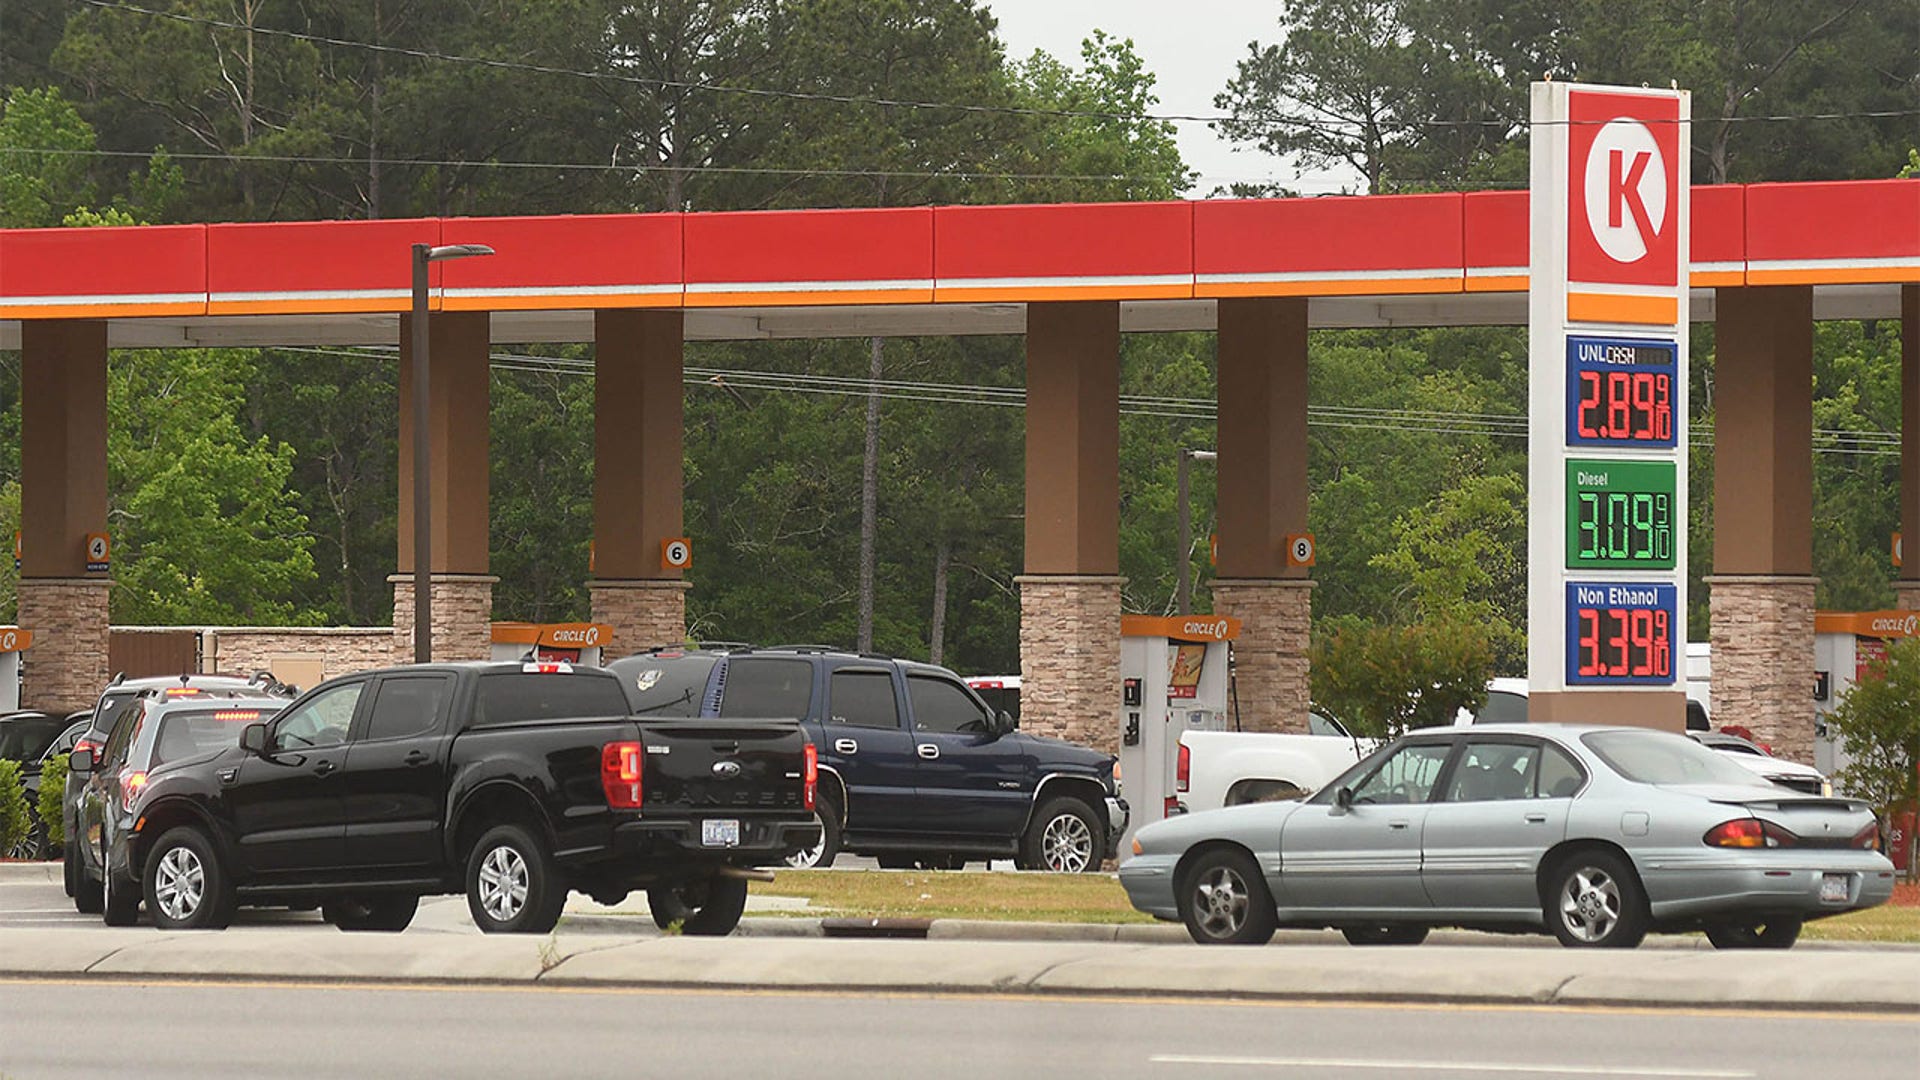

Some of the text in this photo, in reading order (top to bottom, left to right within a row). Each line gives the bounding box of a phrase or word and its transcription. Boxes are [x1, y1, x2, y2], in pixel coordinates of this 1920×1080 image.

[1606, 147, 1659, 253] K
[1578, 344, 1636, 365] UNL CASH
[1577, 371, 1655, 439] 2.89
[1577, 471, 1609, 486] Diesel
[1578, 492, 1654, 559] 3.09
[93, 541, 103, 555] 4
[671, 546, 682, 560] 6
[1297, 542, 1307, 557] 8
[1577, 586, 1659, 606] Non Ethanol
[1183, 620, 1228, 639] CIRCLE K
[1871, 618, 1903, 632] CIRCLE
[553, 626, 599, 646] CIRCLE K
[1577, 608, 1654, 677] 3.39
